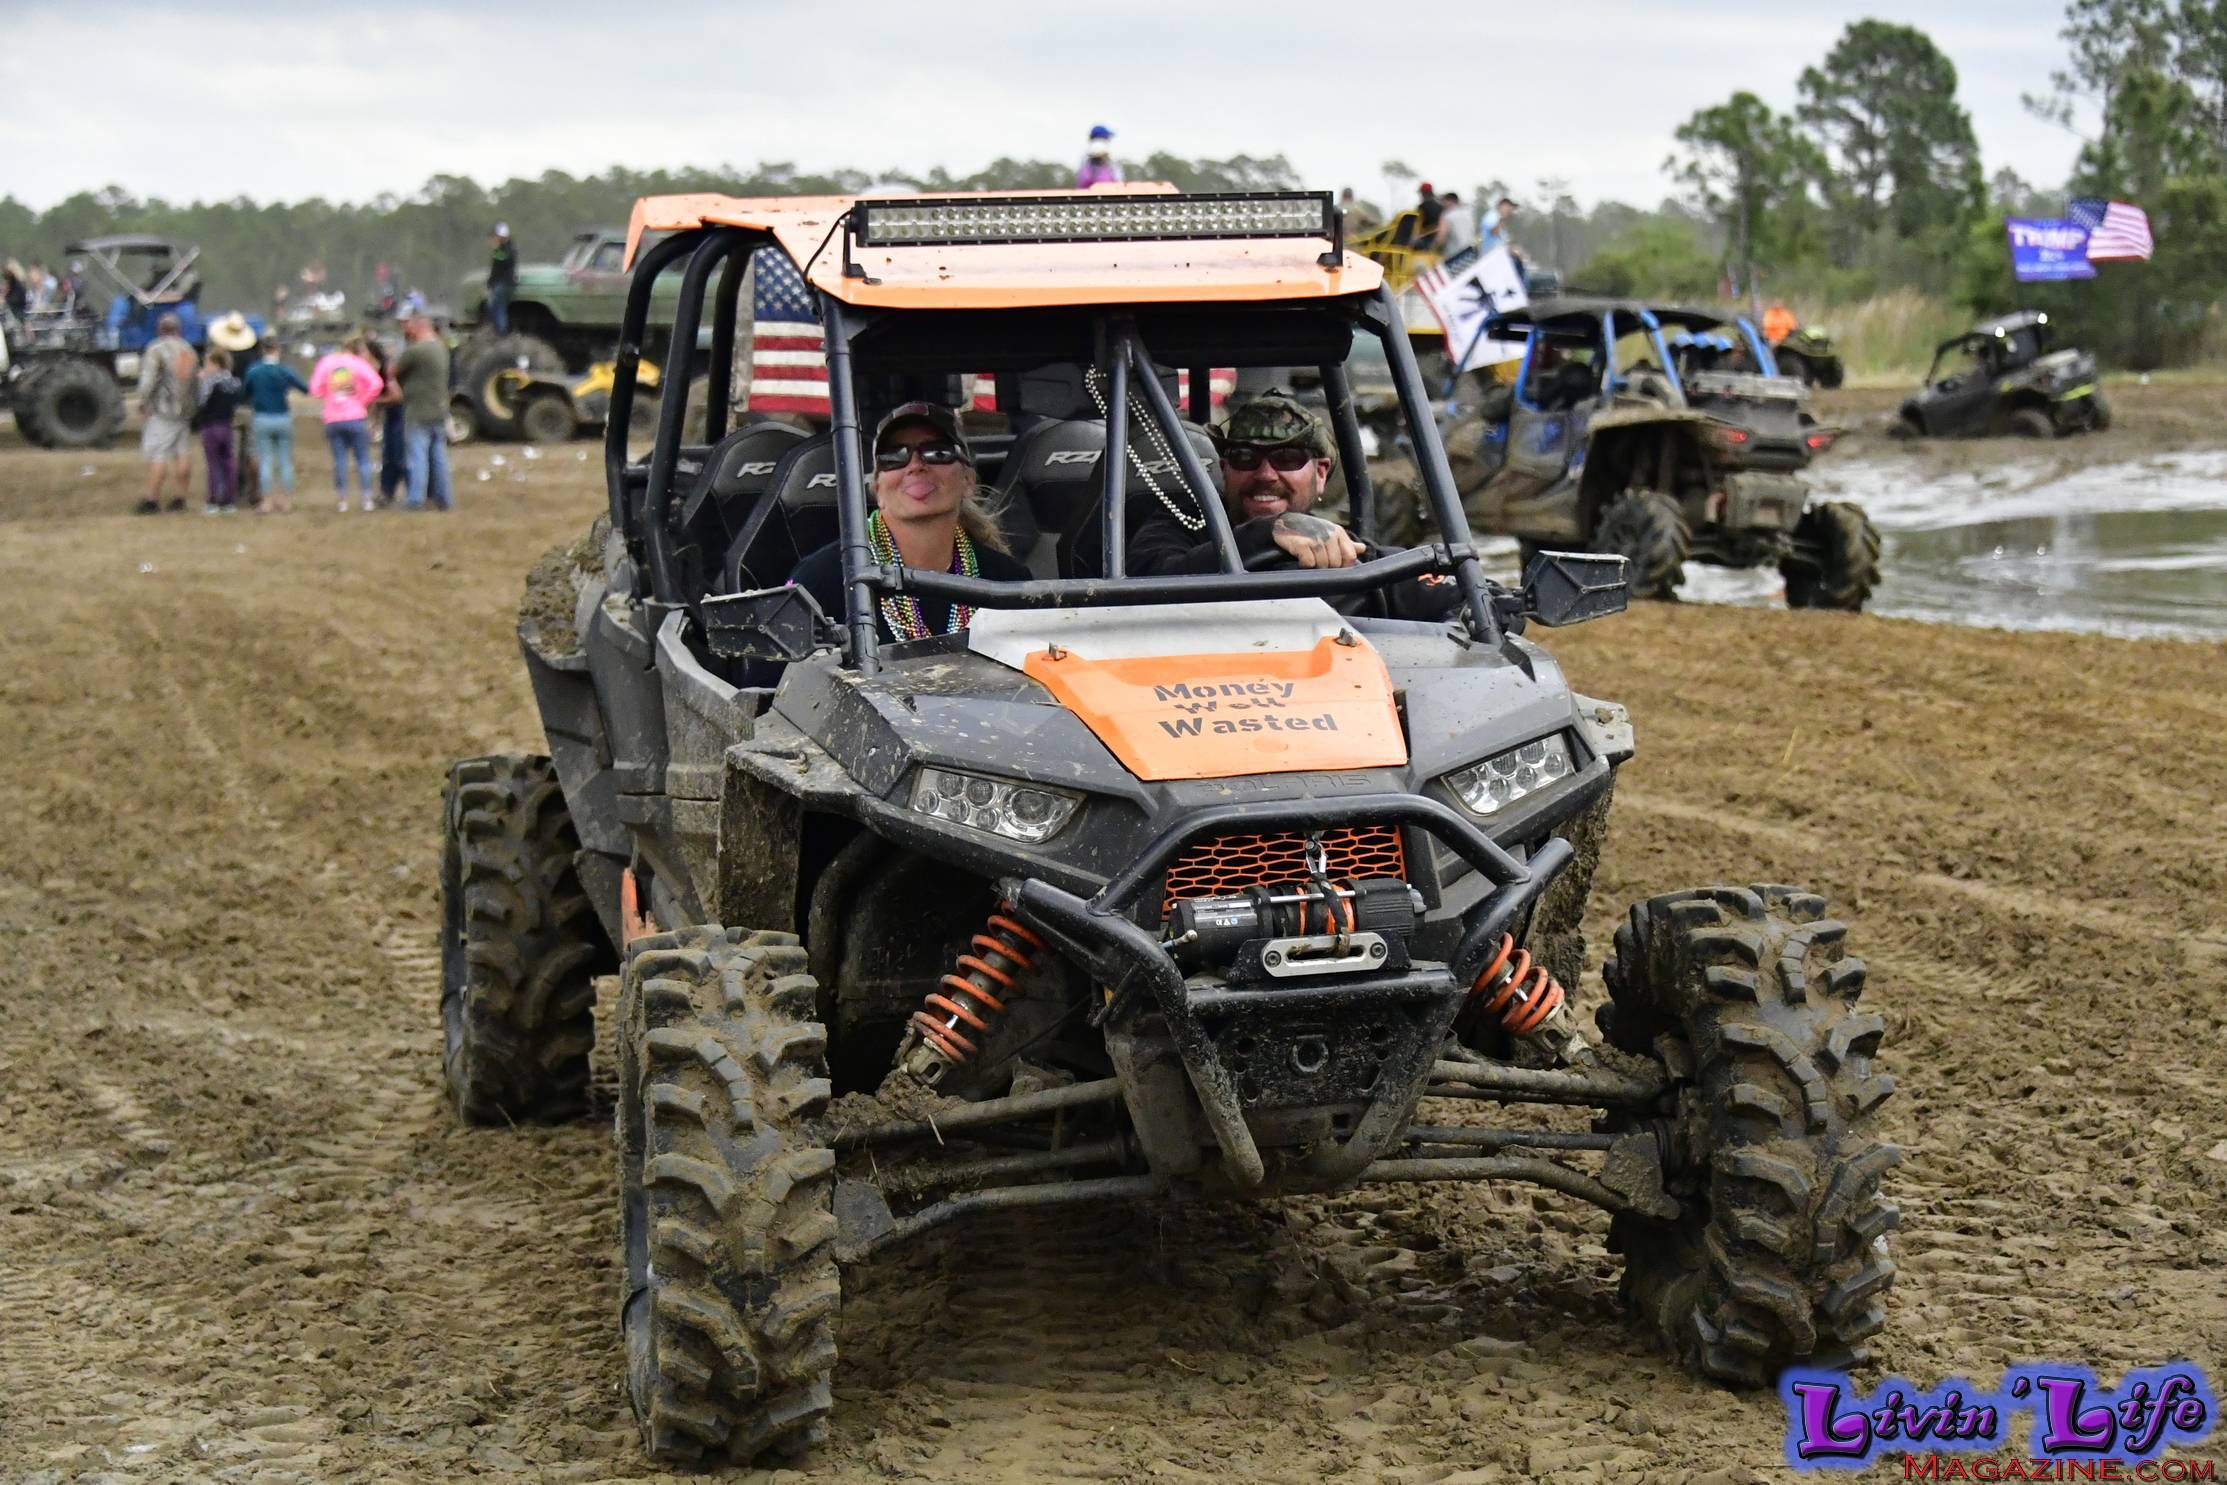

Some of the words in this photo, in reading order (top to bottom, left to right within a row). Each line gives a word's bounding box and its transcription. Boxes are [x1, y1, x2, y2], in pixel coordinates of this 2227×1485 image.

[2008, 223, 2087, 250] TRUMP
[1153, 682, 1294, 702] Money
[1157, 713, 1339, 738] Wasted
